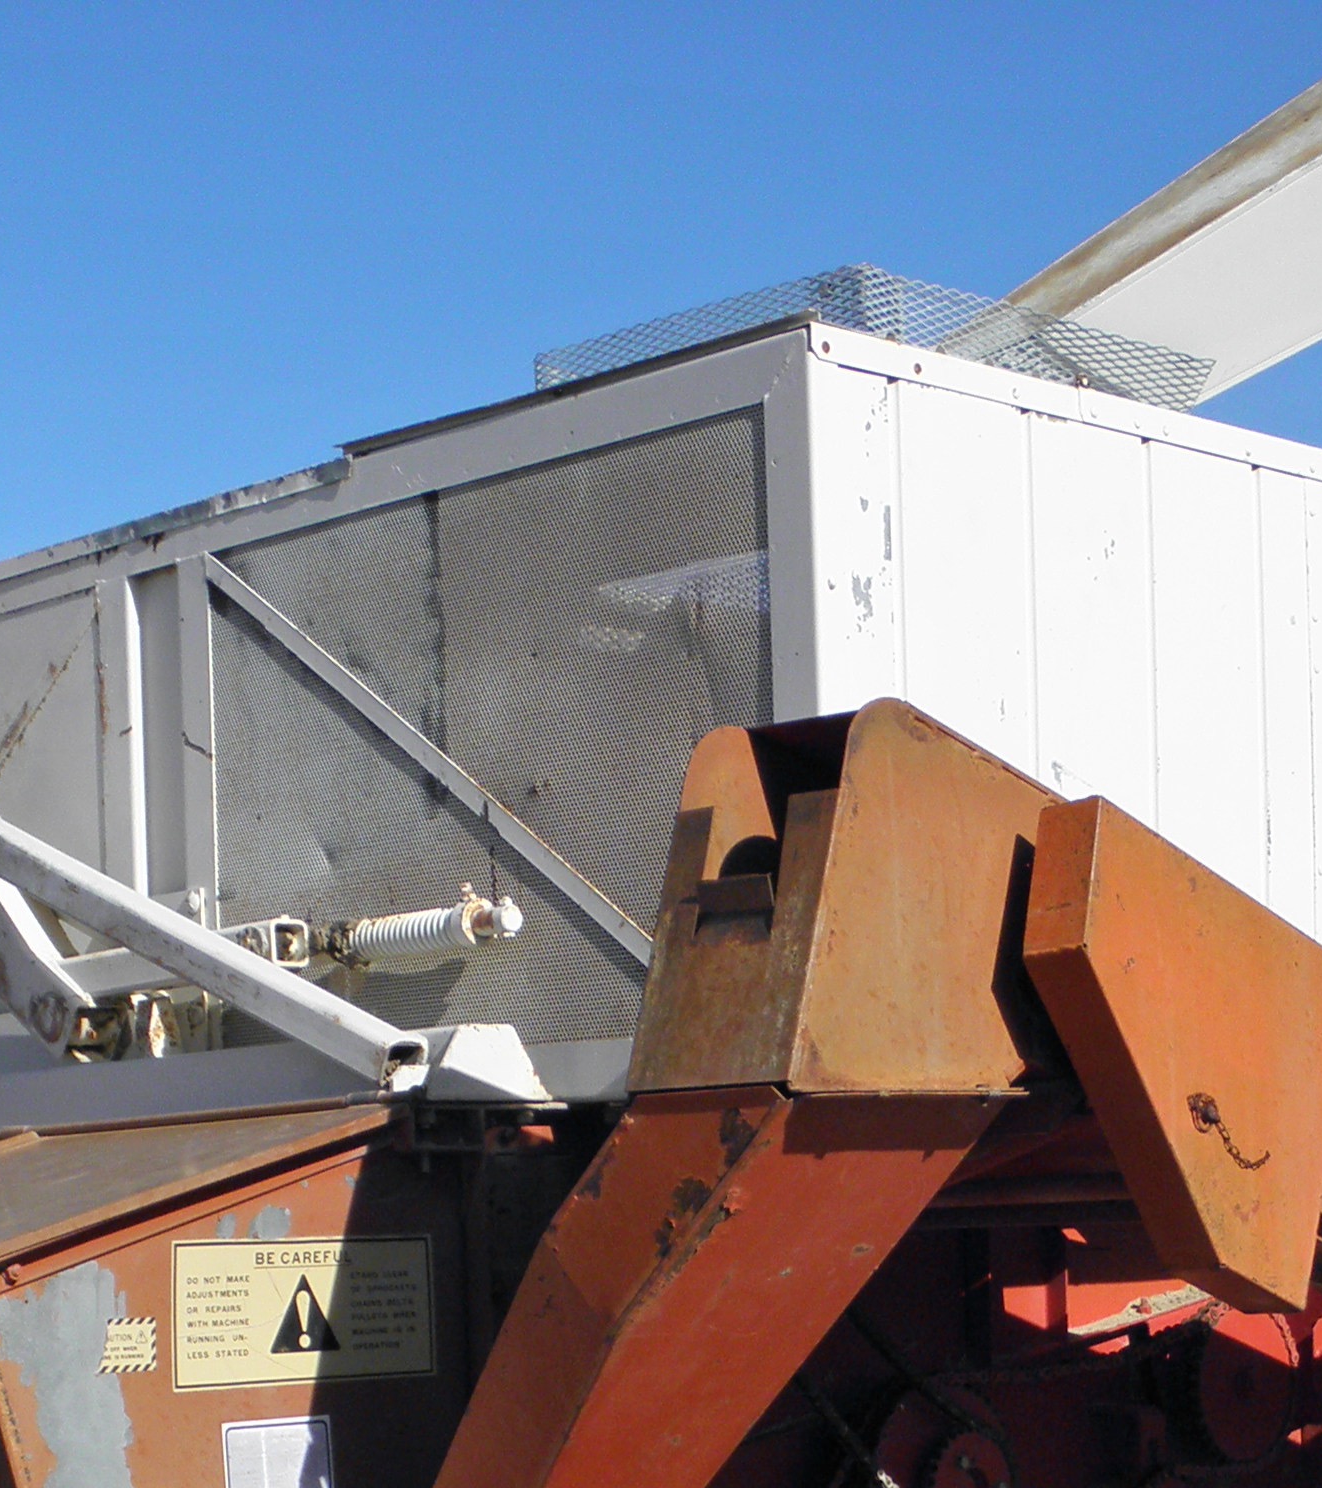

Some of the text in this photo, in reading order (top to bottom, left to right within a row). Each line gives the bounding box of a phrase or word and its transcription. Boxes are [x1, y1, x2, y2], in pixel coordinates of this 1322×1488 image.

[254, 1250, 352, 1265] BE CAREFUL
[203, 1276, 221, 1284] NOT
[226, 1275, 251, 1283] MAKE
[186, 1290, 250, 1299] ADJUSTMENTS
[186, 1305, 242, 1314] OR REPAIRS
[187, 1318, 250, 1328] WITH MACHINE
[186, 1335, 226, 1343] RUNNING
[187, 1349, 250, 1360] LESS STATED
